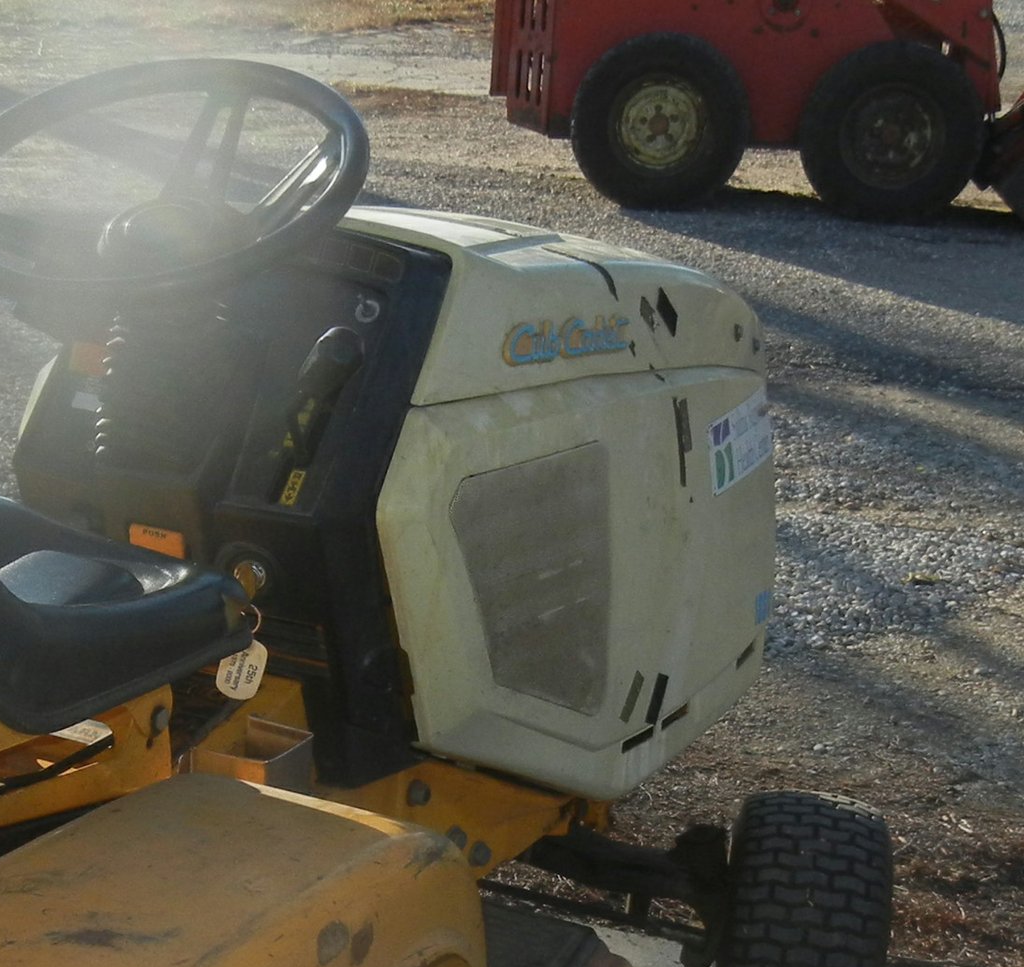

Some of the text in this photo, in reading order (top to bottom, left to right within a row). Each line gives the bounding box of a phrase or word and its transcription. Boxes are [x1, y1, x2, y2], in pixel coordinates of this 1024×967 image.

[504, 314, 630, 366] Cub Cadet
[142, 527, 167, 539] PUSH
[230, 651, 250, 691] Anniversary
[244, 663, 258, 685] 25th
